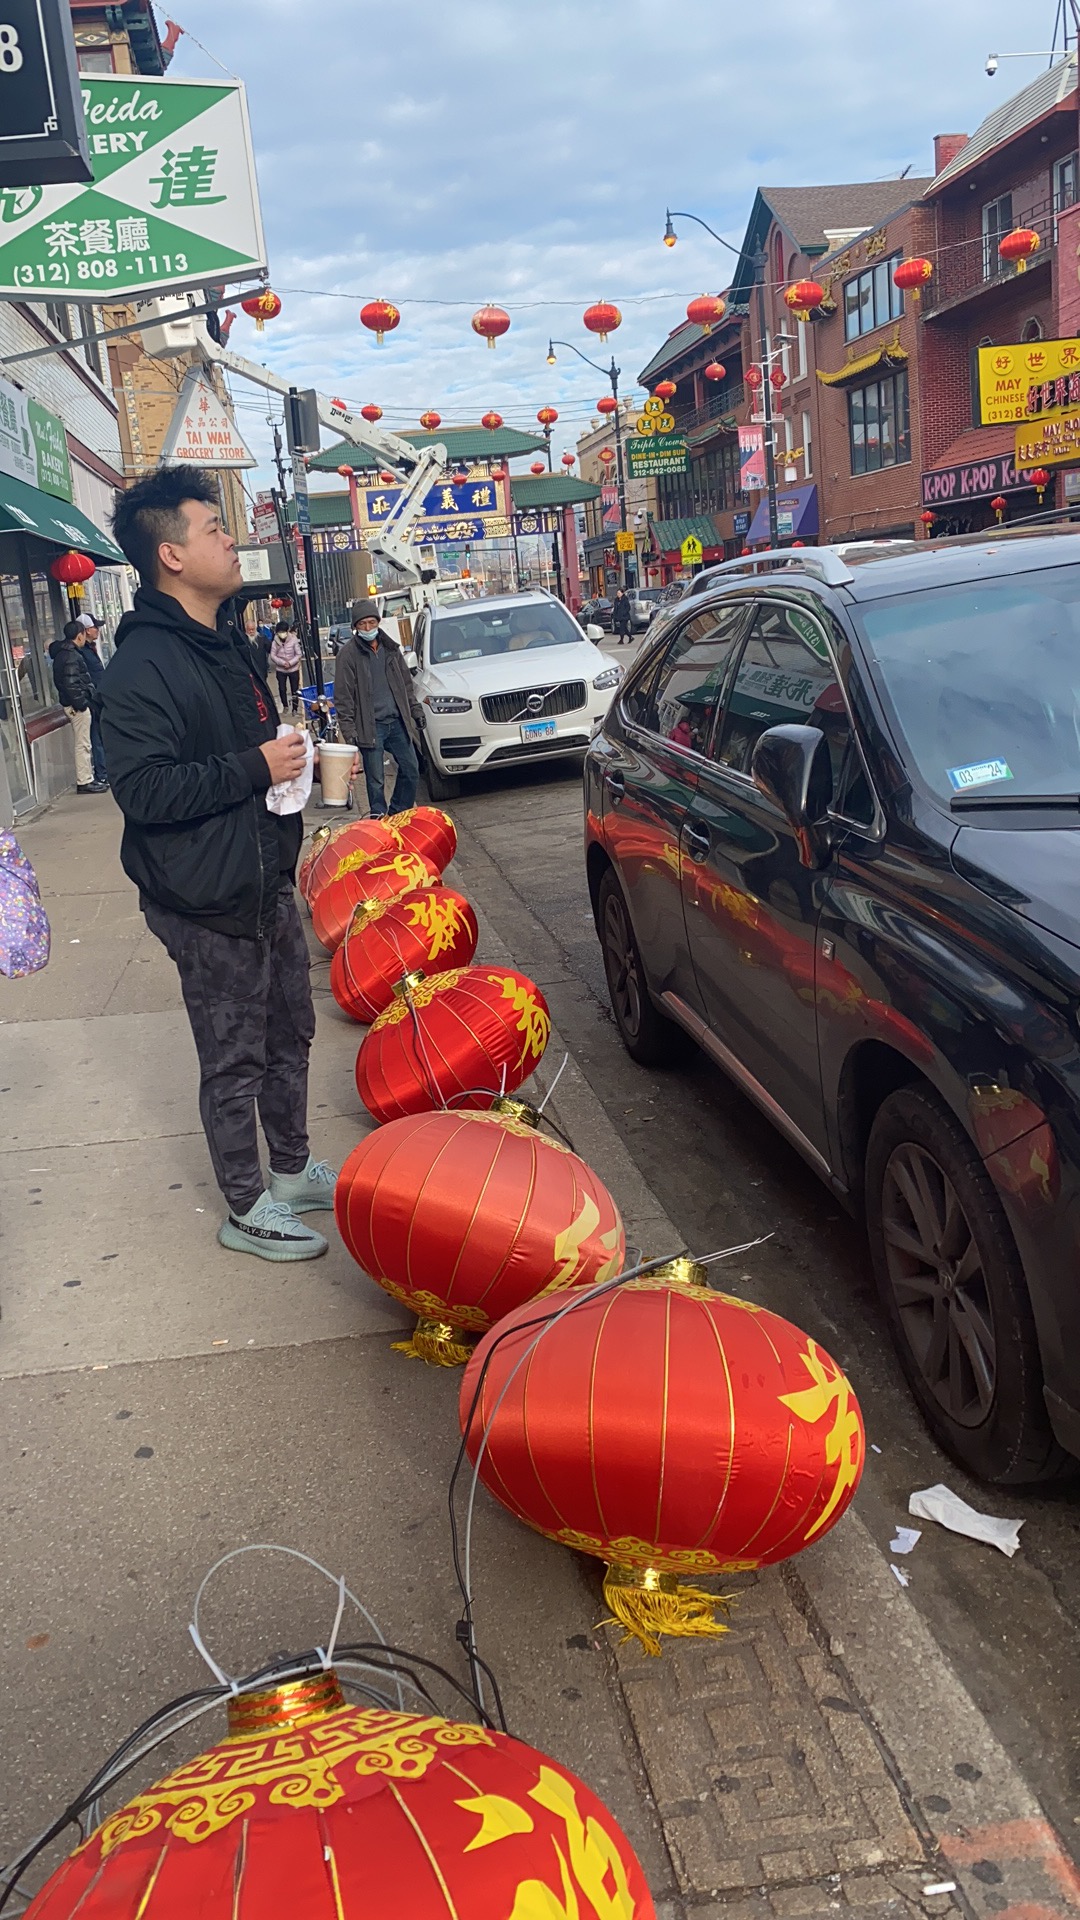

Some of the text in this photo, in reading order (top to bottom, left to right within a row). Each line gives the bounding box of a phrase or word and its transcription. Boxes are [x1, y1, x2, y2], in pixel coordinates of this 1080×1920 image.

[43, 216, 150, 257] 茶餐廳
[14, 263, 70, 287] (312)
[77, 259, 118, 279] 808
[995, 347, 1079, 369] 好世界
[996, 378, 1021, 391] MAY
[198, 381, 210, 415] 大華
[986, 393, 1025, 406] CHINESE
[184, 415, 228, 429] 食品公司
[1043, 423, 1061, 437] MAY
[186, 431, 231, 445] TAI WAH
[630, 438, 655, 452] Triple
[740, 433, 762, 445] CHINA
[177, 447, 245, 459] GROCERY STORE
[631, 448, 686, 461] DINE-IN DIM SUM
[742, 442, 763, 453] TOWN
[41, 449, 64, 476] BAKERY
[632, 456, 686, 469] RESTAURANT
[633, 465, 687, 477] 312-842-0088
[924, 472, 956, 501] K-POP
[961, 463, 997, 495] K-POP
[959, 769, 974, 784] 03
[987, 762, 1003, 777] 24
